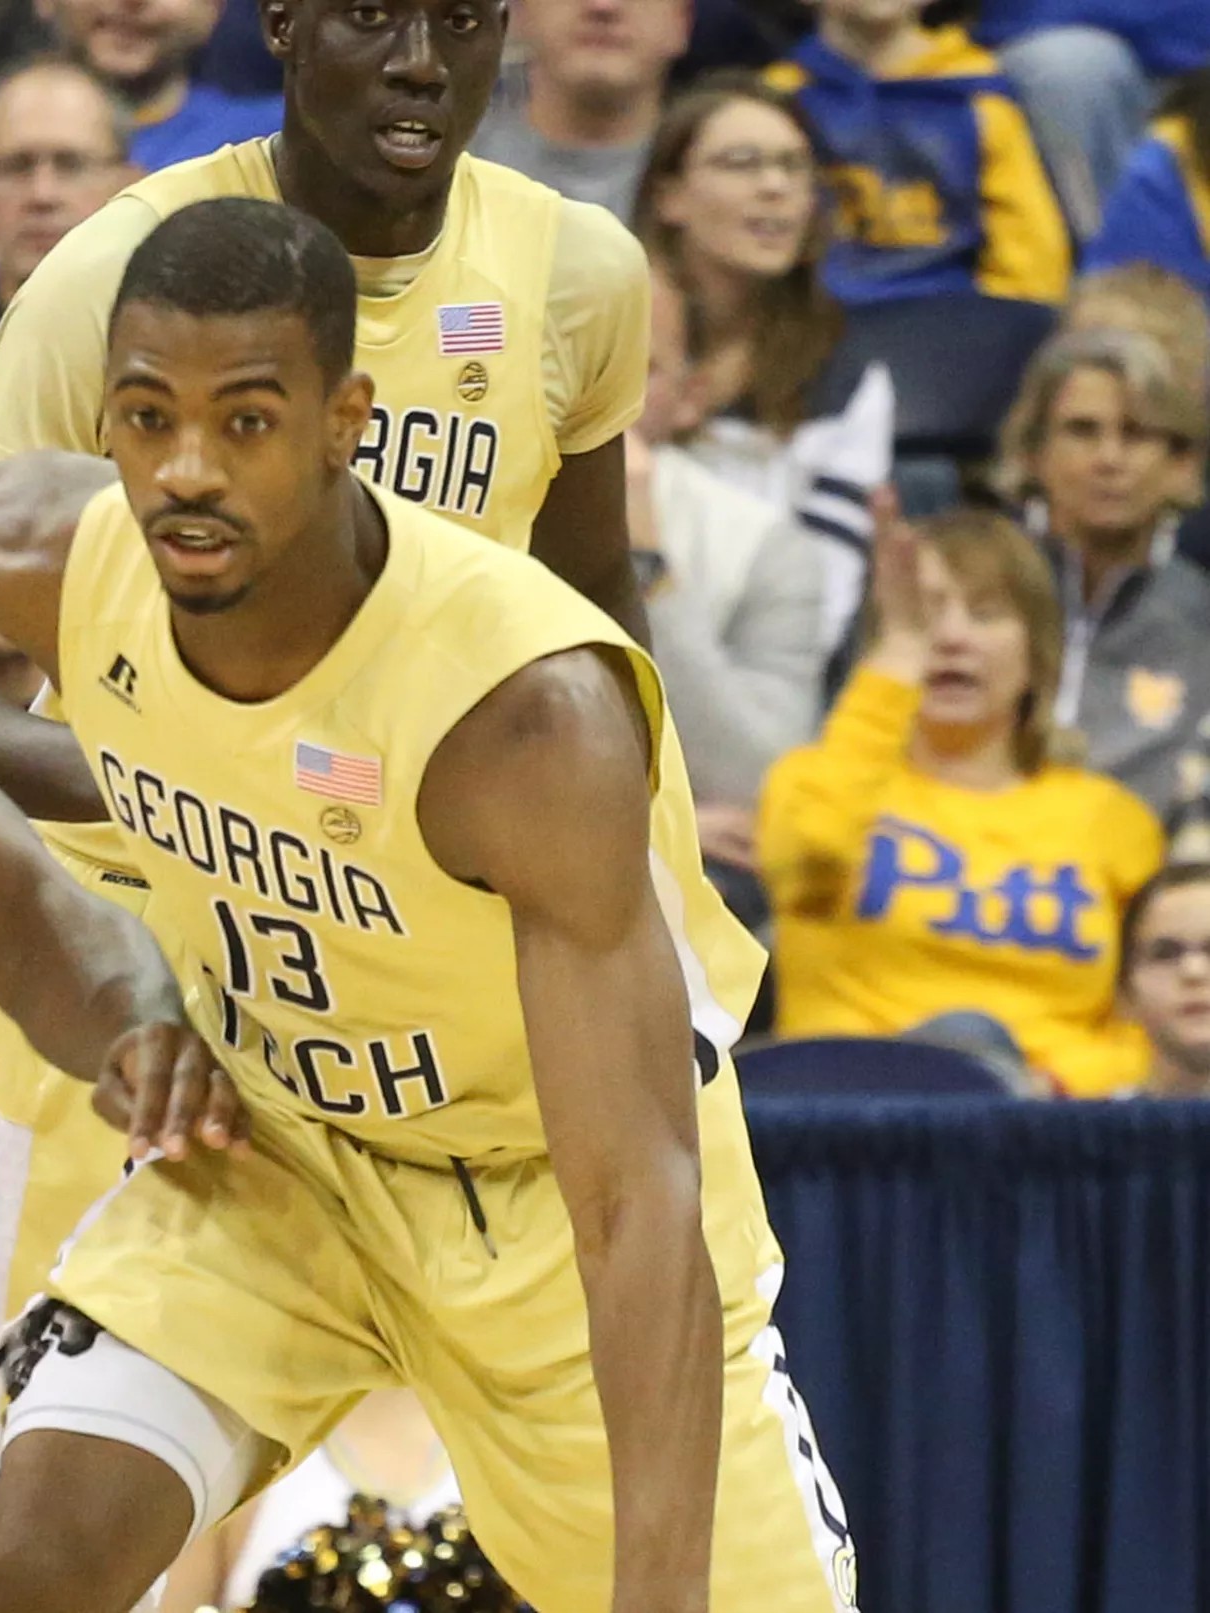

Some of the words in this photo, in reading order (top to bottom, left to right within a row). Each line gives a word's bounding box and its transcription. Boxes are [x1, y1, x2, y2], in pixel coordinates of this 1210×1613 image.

[351, 406, 497, 515] RGIA
[99, 750, 406, 935] GEORGIA
[856, 813, 1102, 961] Pitt
[214, 900, 331, 1013] 13
